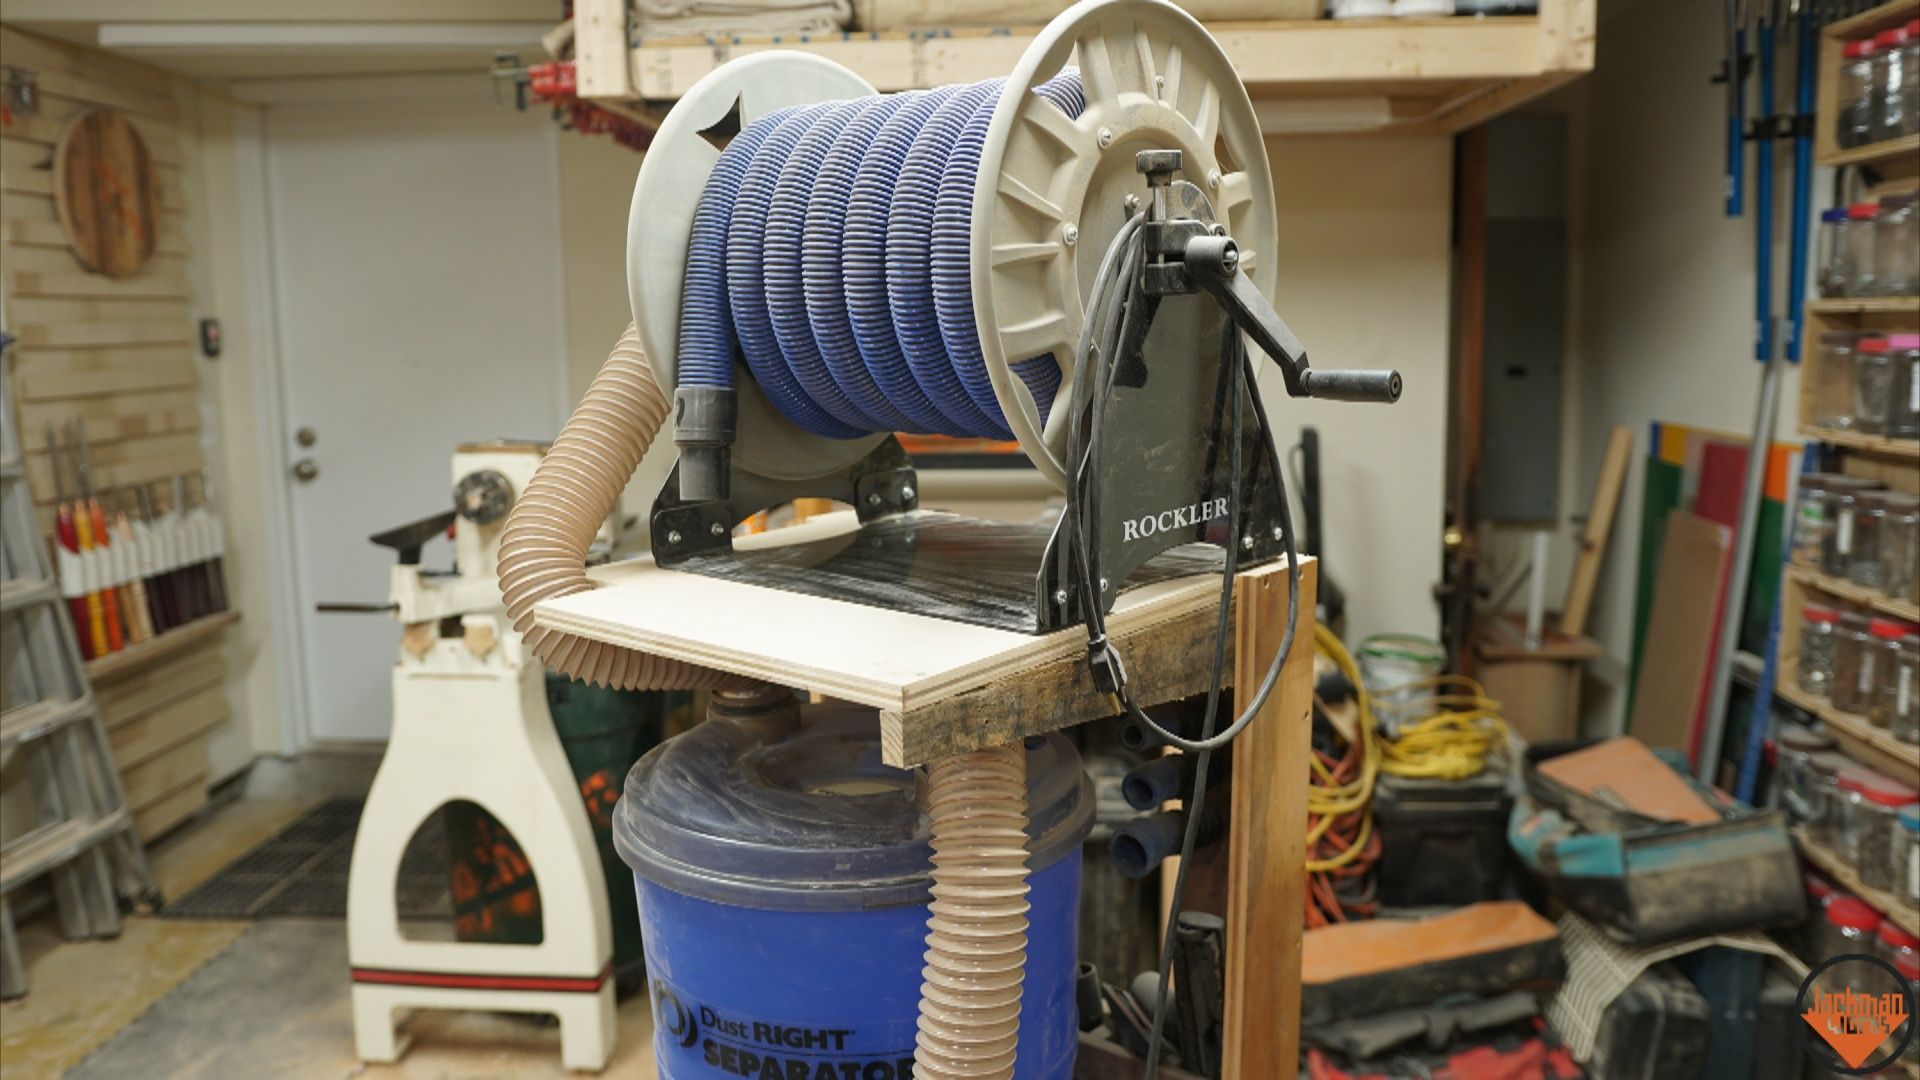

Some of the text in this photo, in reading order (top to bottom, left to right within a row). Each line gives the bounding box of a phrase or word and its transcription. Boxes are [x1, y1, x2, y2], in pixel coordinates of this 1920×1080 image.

[1123, 498, 1229, 542] ROCKLER
[701, 1006, 850, 1050] Dust RIGHT
